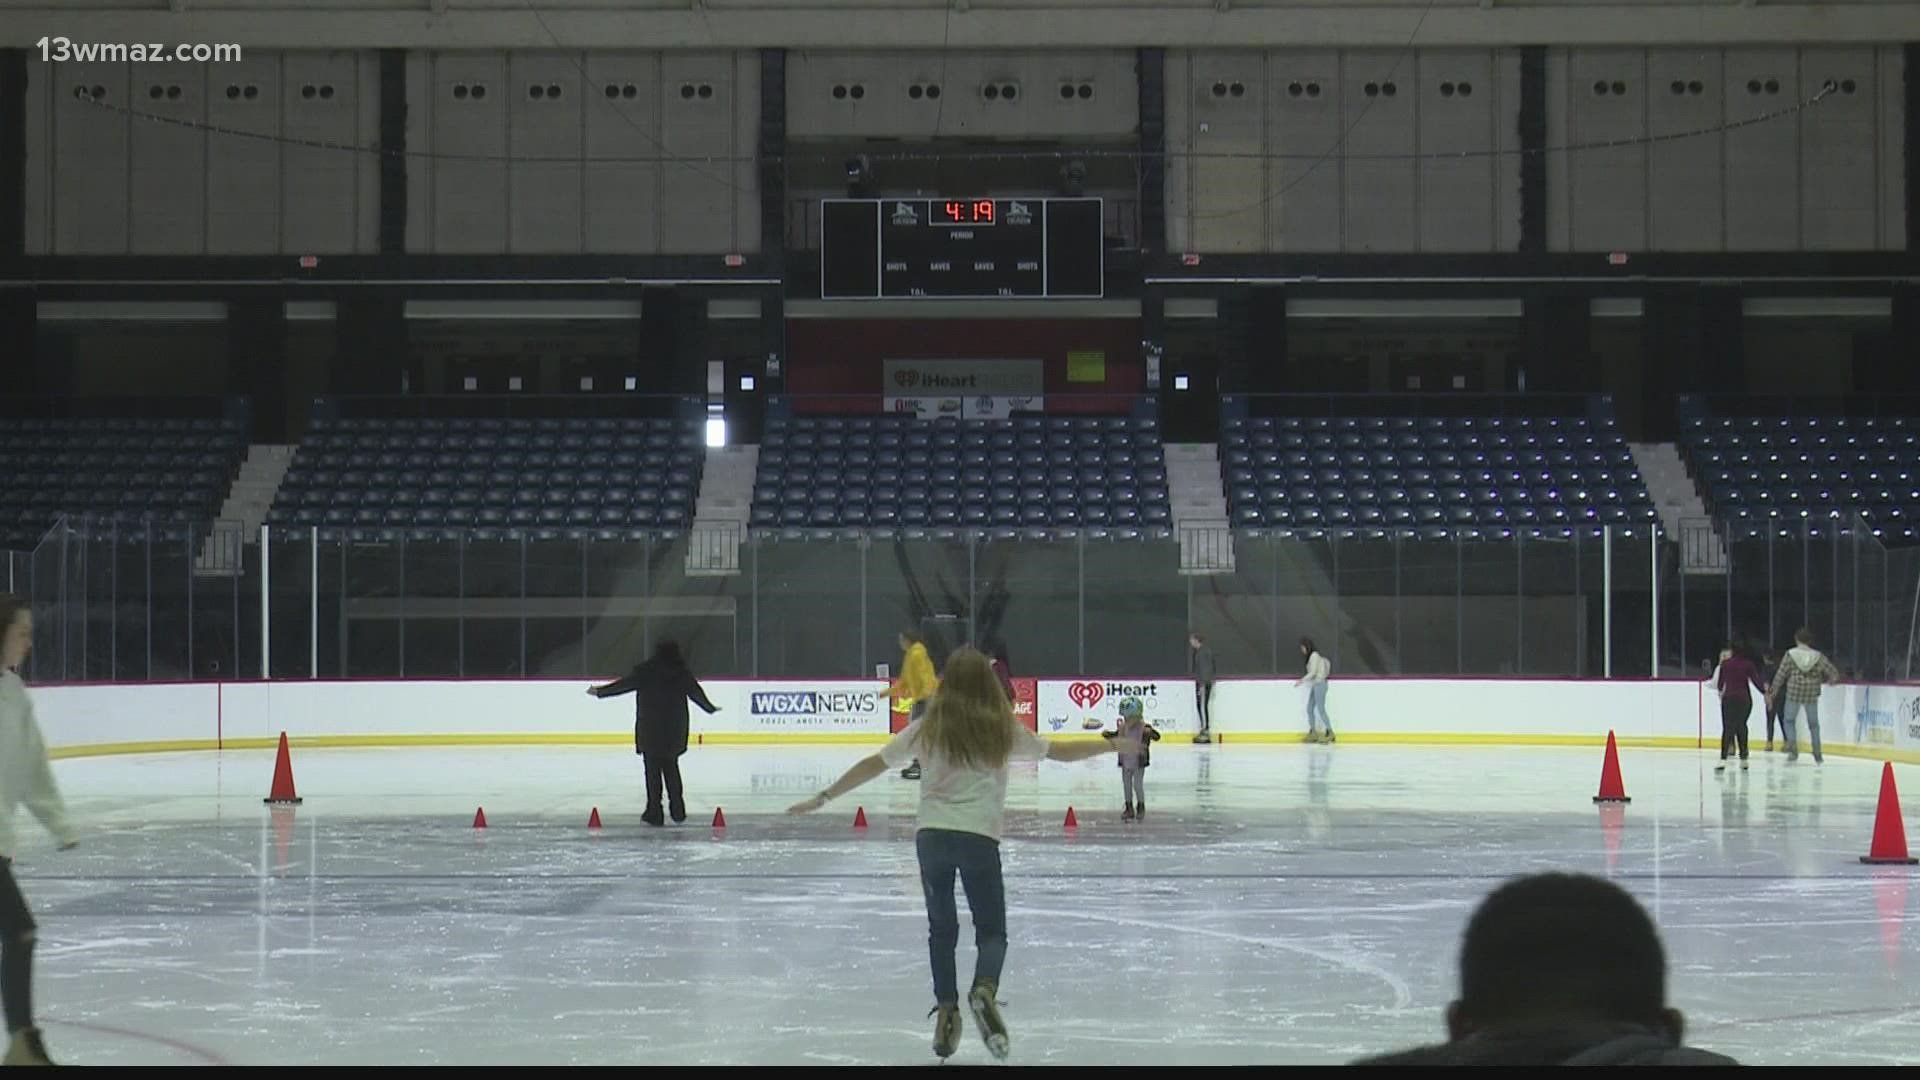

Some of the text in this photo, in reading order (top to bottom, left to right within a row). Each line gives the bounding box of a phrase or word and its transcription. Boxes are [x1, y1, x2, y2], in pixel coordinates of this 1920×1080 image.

[945, 200, 993, 222] 4:19
[950, 231, 974, 240] PERIOD
[886, 262, 908, 271] SHOTS
[930, 262, 951, 271] SAVES
[974, 262, 995, 271] SAVES
[1017, 262, 1038, 271] SHOTS
[921, 372, 977, 388] iHeart
[1106, 683, 1158, 697] iHeart
[754, 694, 875, 713] WGXA NEWS
